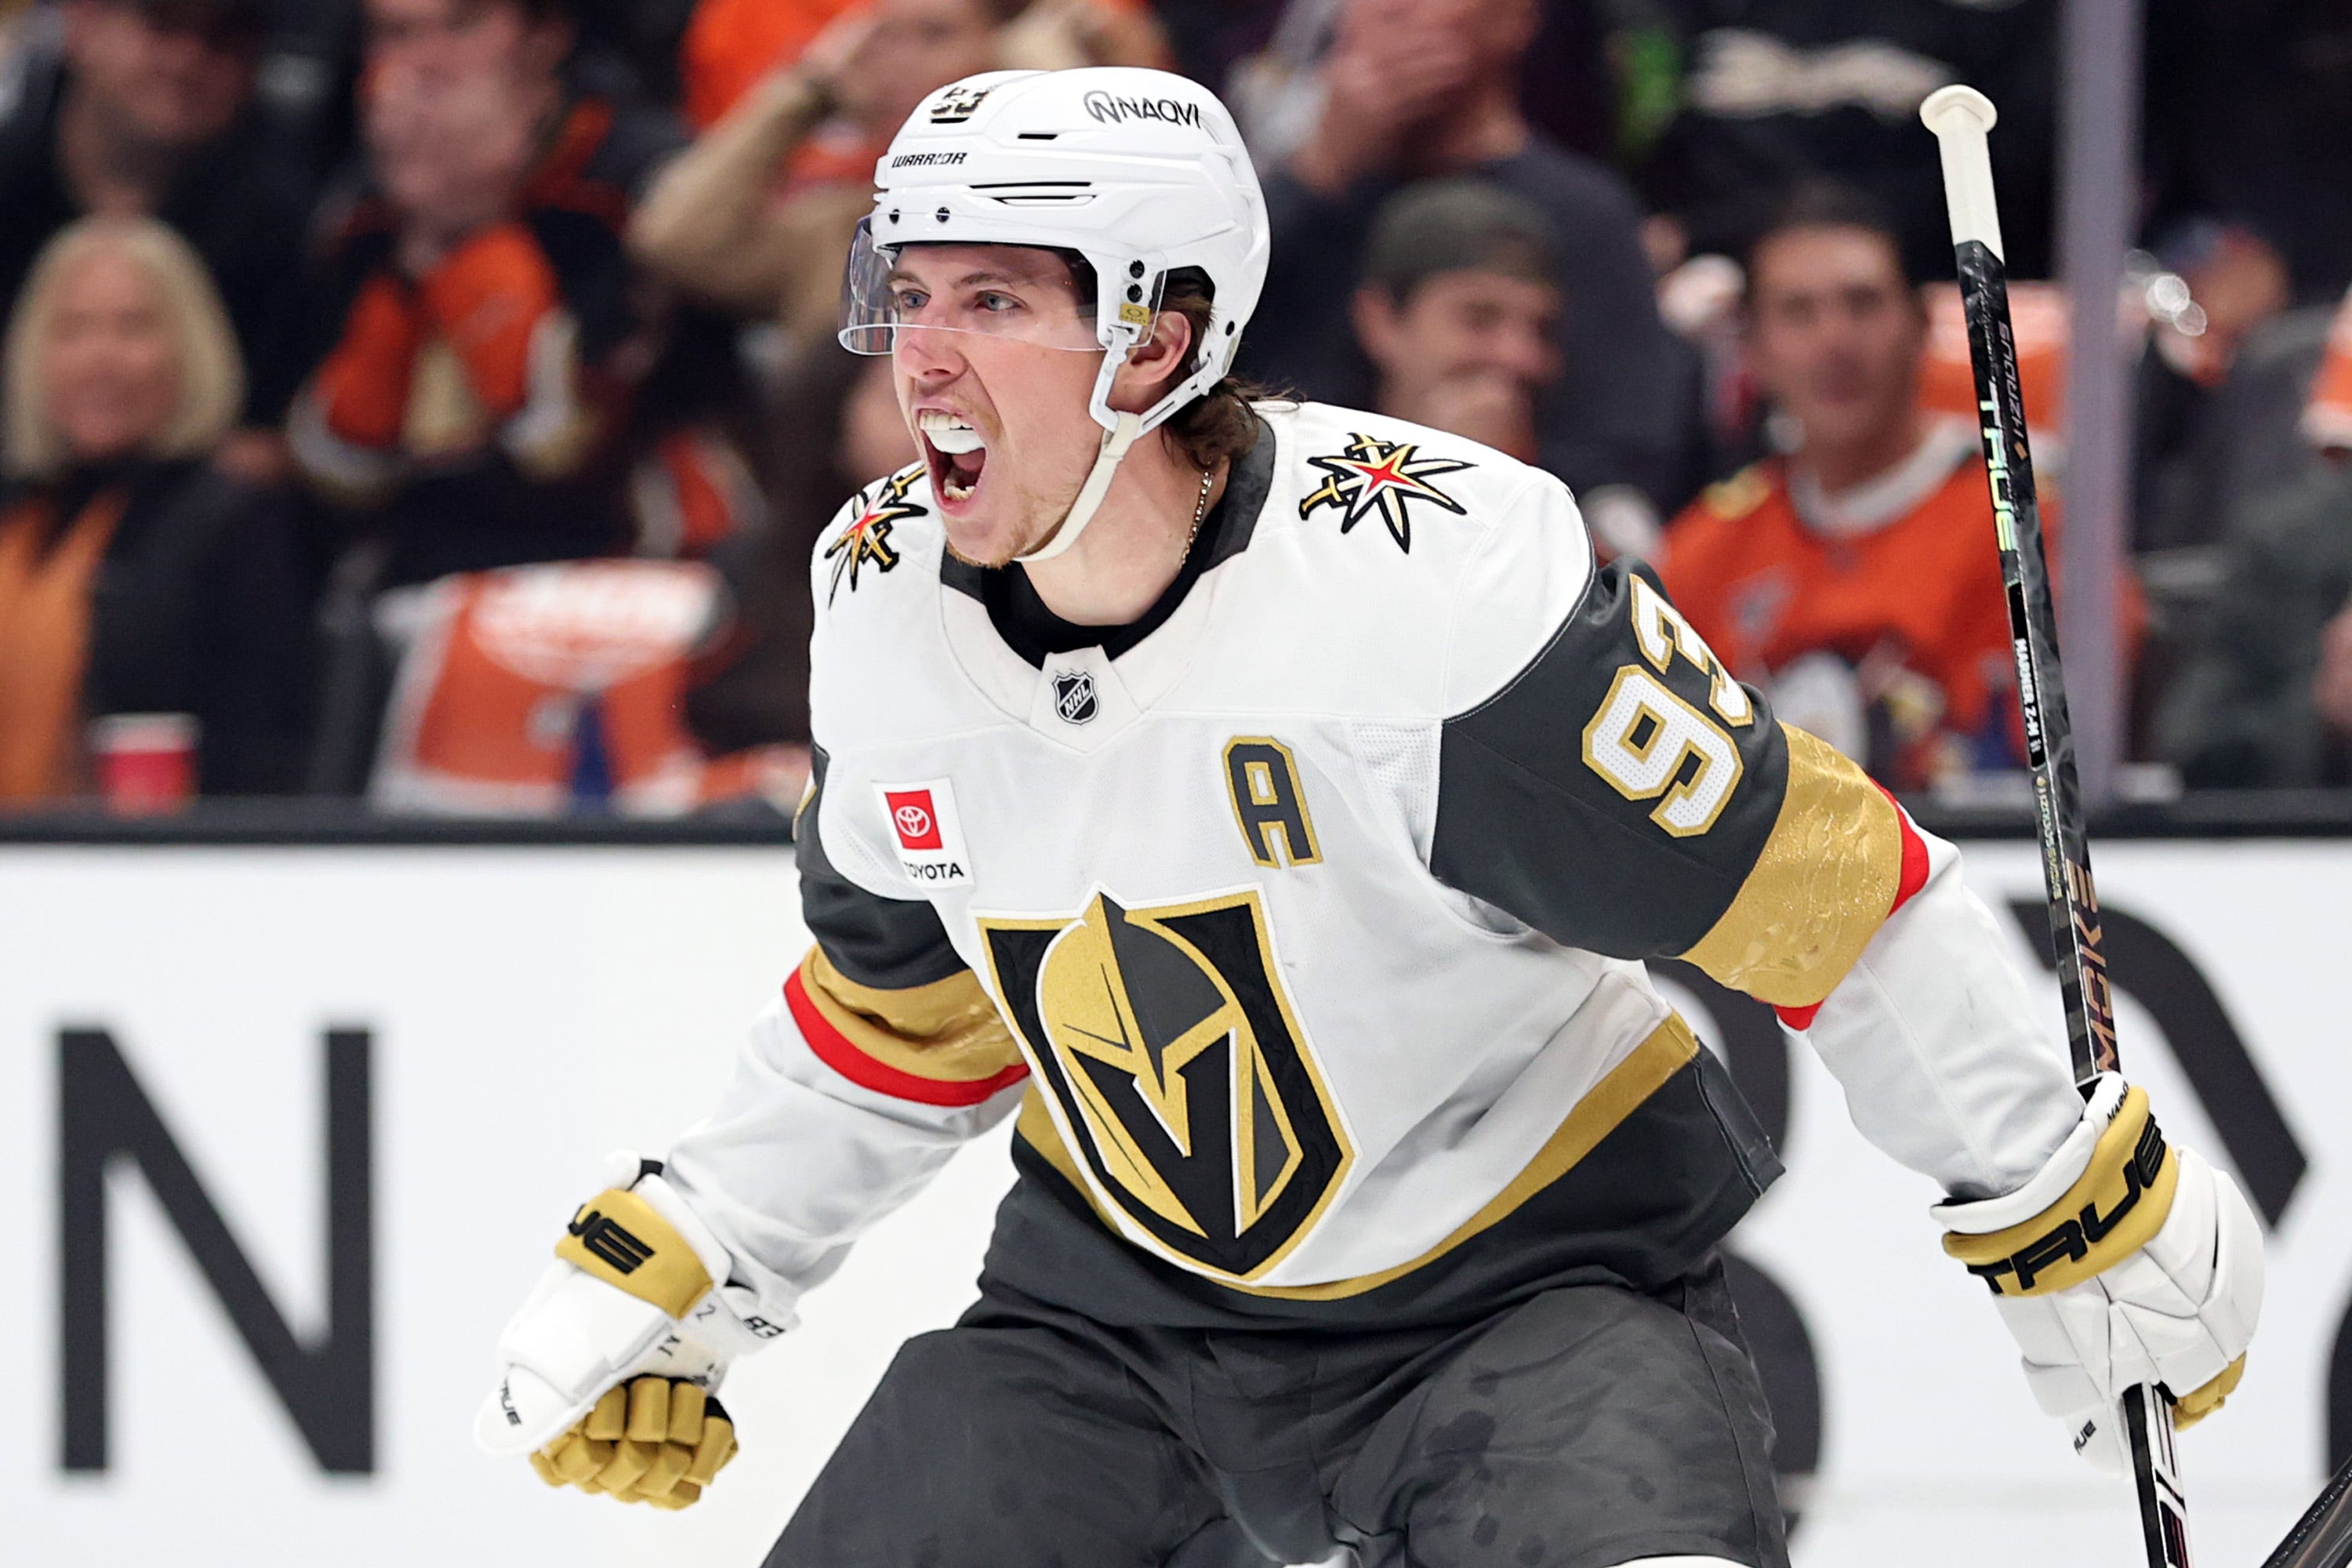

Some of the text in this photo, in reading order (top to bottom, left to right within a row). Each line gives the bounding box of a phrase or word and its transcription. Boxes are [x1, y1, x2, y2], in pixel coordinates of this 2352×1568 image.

[891, 152, 967, 169] WARRIOR
[1116, 96, 1201, 129] NAQVI
[1980, 380, 2020, 553] TRUE
[1064, 684, 1091, 717] NHL
[1581, 572, 1755, 838] 93
[1221, 734, 1324, 869] A
[2065, 858, 2115, 1072] MOKE
[568, 1204, 655, 1275] UE
[1966, 1112, 2167, 1294] TRUE
